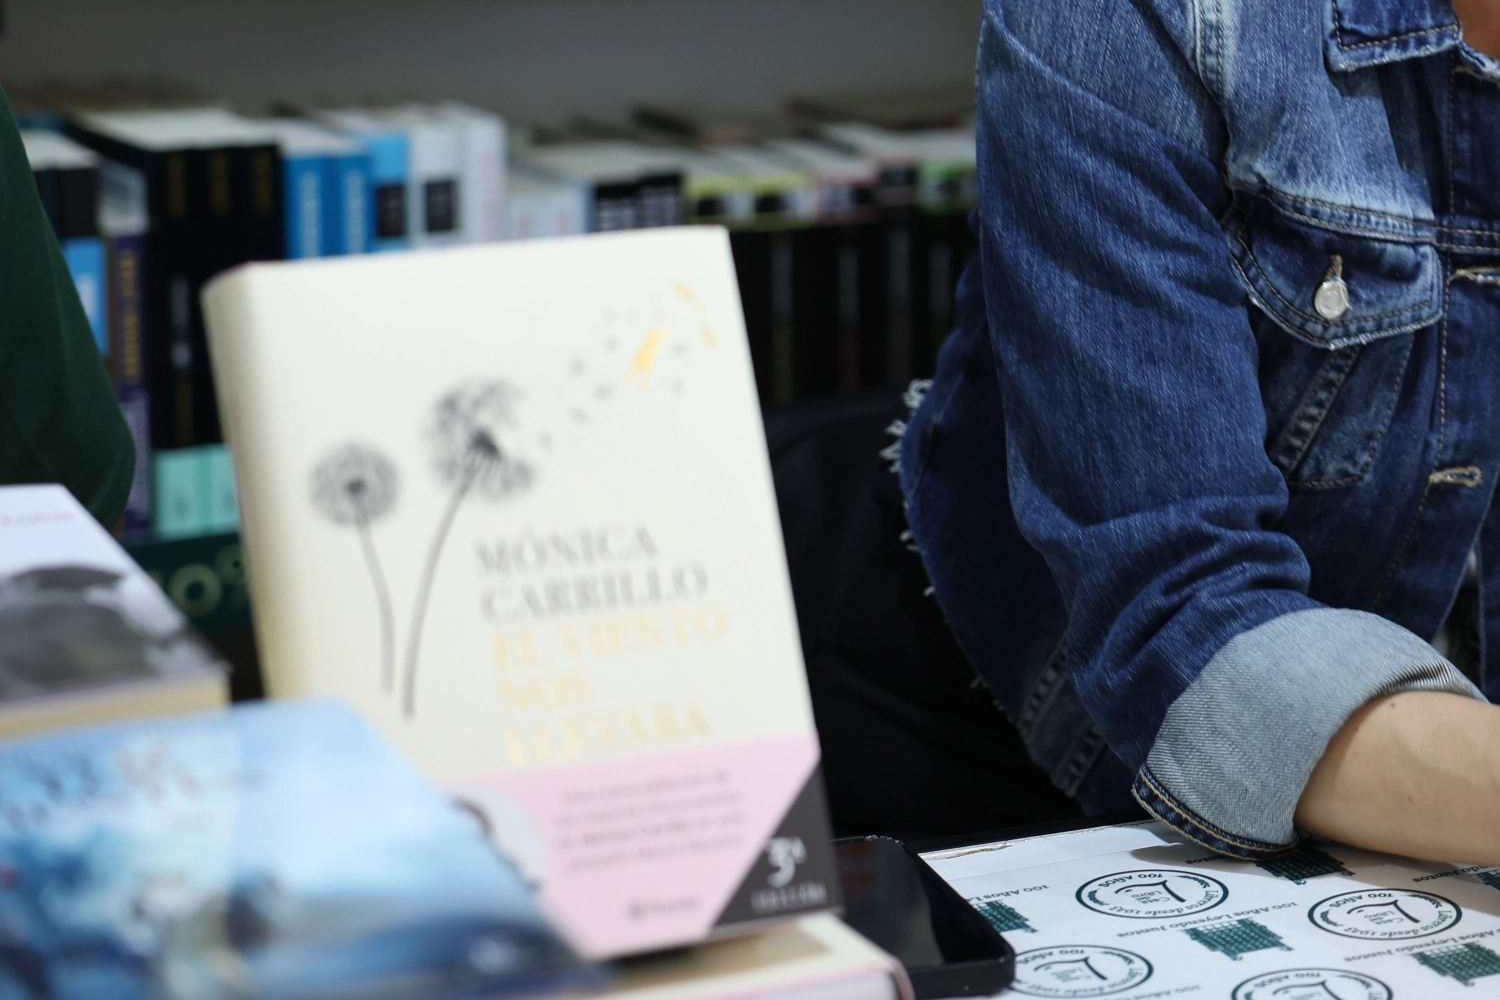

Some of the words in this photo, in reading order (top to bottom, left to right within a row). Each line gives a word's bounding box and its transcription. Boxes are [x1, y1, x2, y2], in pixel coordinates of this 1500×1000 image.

[475, 526, 658, 577] MÓNICA
[479, 564, 709, 625] CARRILLO
[1099, 874, 1133, 888] AÑOS
[1412, 870, 1459, 883] Juntos
[984, 889, 1020, 898] Años
[1144, 907, 1183, 916] desde
[1233, 907, 1270, 916] Años
[1272, 901, 1299, 909] 100
[1169, 913, 1232, 928] Leyendo
[1117, 926, 1165, 937] Juntos
[1459, 930, 1494, 939] Años
[1396, 936, 1458, 953] Leyendo
[1344, 949, 1392, 962] Juntos
